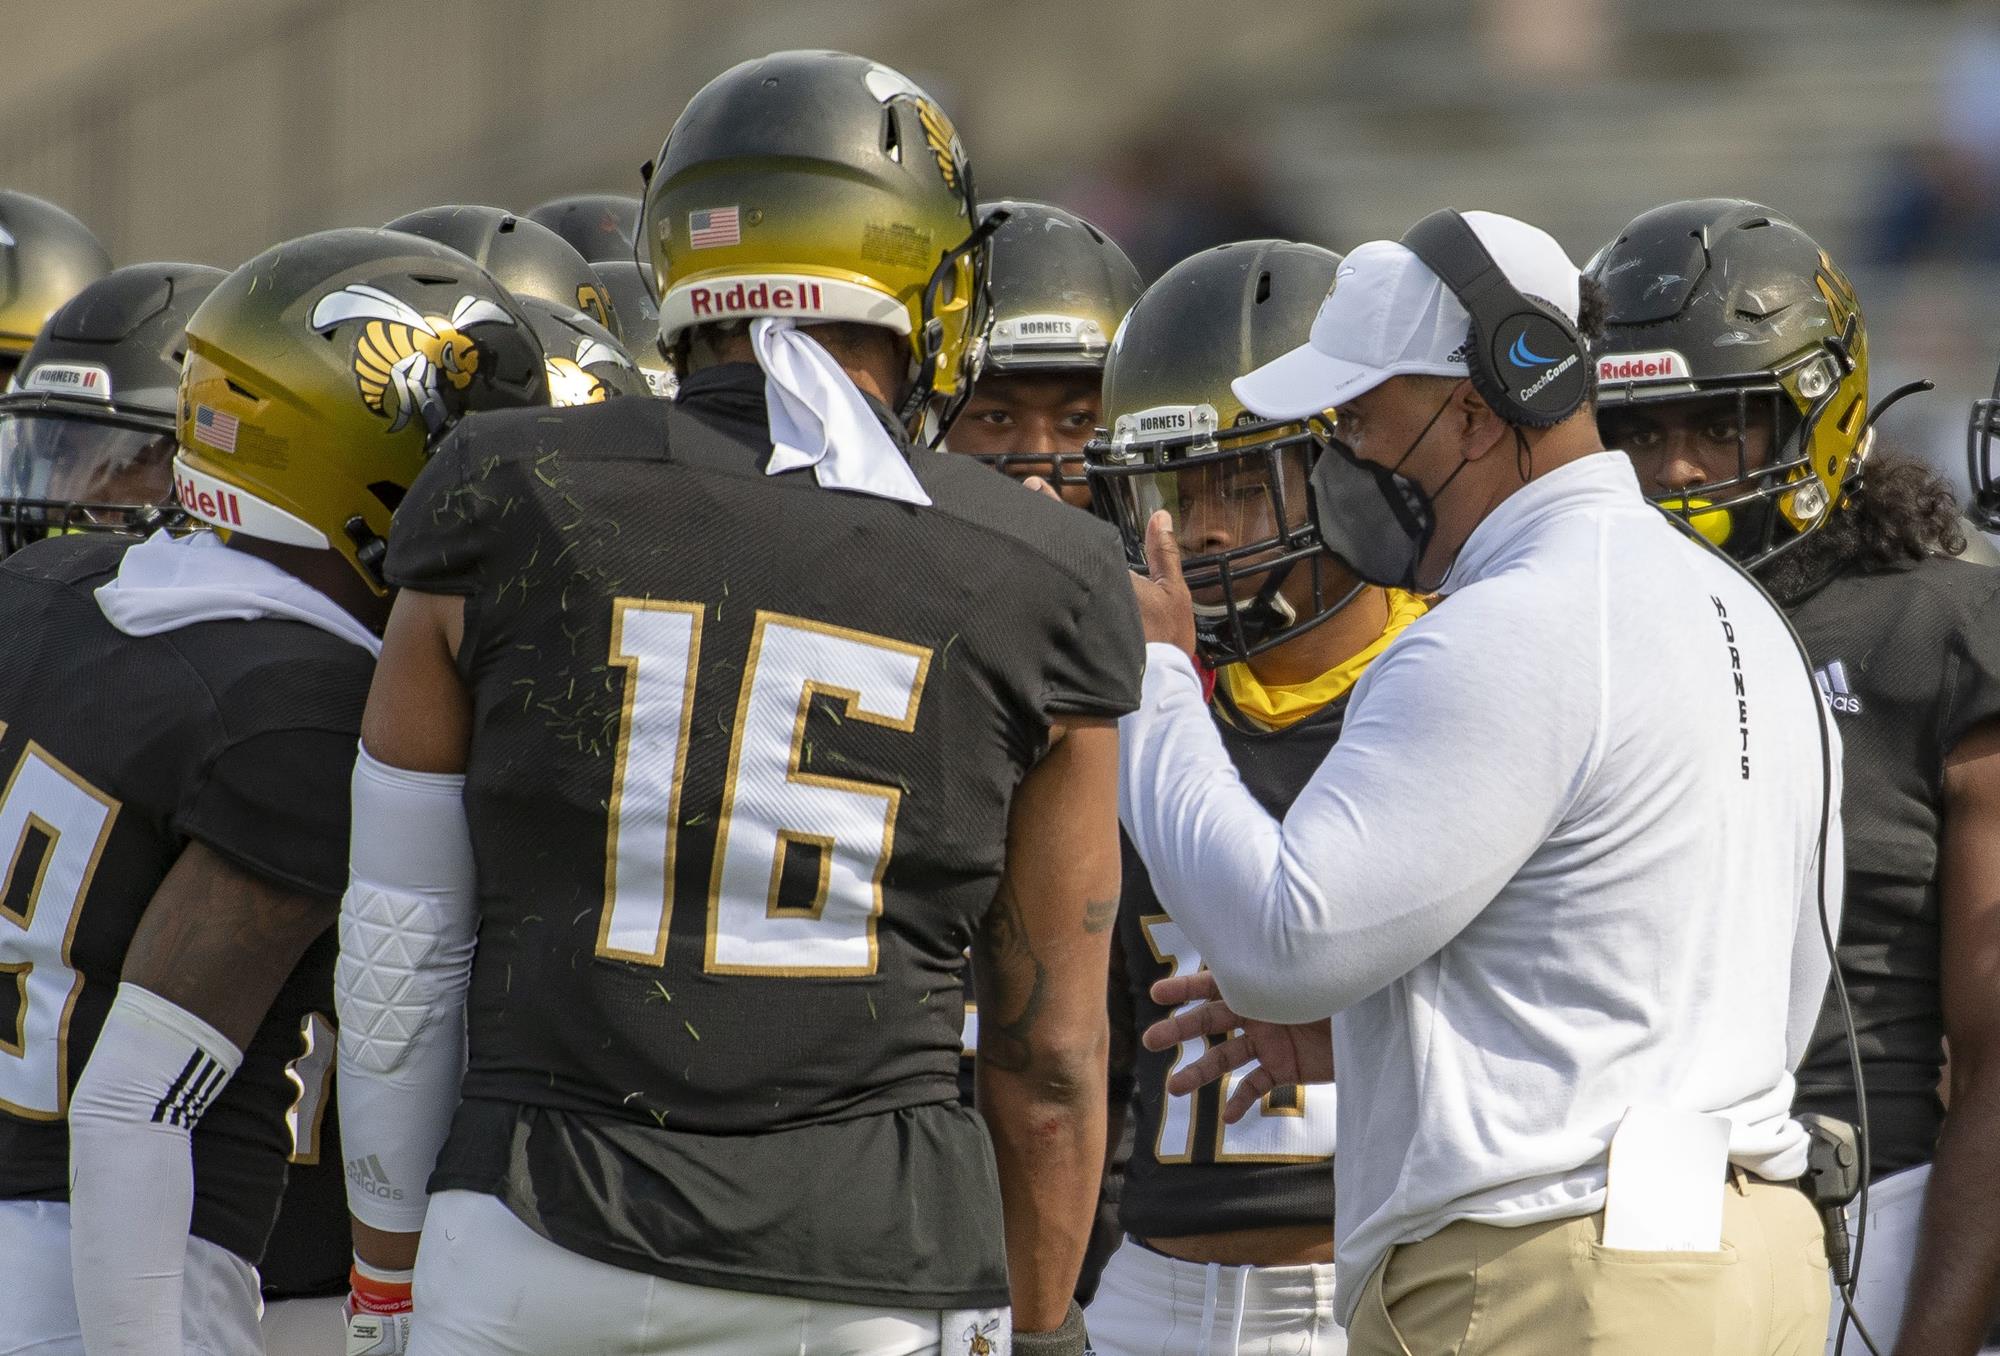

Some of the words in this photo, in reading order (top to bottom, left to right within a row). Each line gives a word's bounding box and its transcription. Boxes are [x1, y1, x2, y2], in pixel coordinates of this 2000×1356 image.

[690, 282, 822, 316] Riddell
[1020, 321, 1072, 334] HORNETS
[40, 369, 80, 384] HORNETS
[1600, 357, 1672, 380] Riddell
[1140, 414, 1185, 431] HORNETS
[1709, 593, 1750, 780] HORNETS
[595, 597, 934, 977] 16
[346, 1164, 404, 1201] adidas
